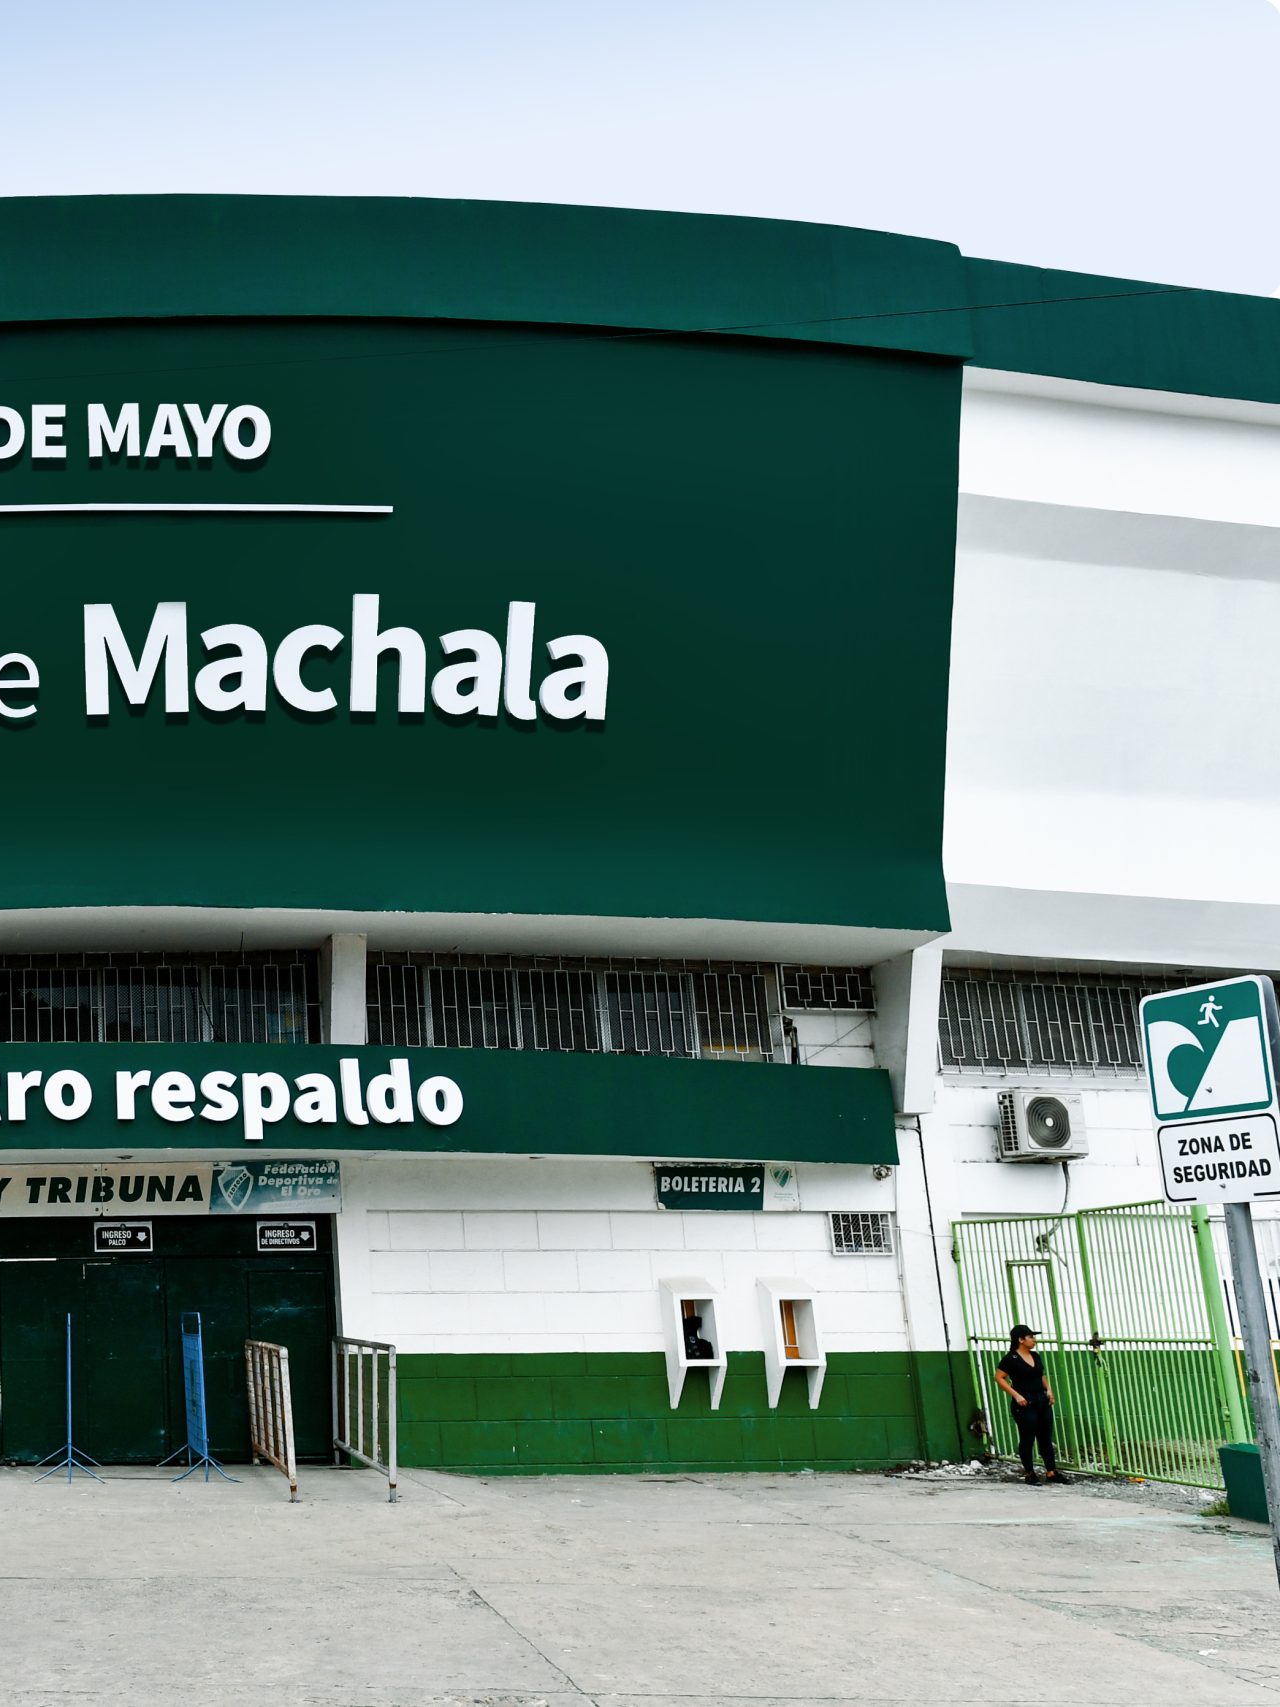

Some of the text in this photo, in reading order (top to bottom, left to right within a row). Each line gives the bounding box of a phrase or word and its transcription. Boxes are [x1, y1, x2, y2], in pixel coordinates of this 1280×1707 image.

[87, 402, 272, 460] MAYO
[83, 593, 609, 720] Machala
[116, 1058, 464, 1140] respaldo
[1178, 1132, 1253, 1156] ZONA DE
[264, 1162, 336, 1174] Federación
[1173, 1158, 1272, 1184] SEGURIDAD
[26, 1175, 204, 1204] TRIBUNA
[258, 1175, 338, 1188] Deportiva de
[281, 1186, 321, 1196] El Oro
[660, 1176, 761, 1193] BOLETERIA 2
[102, 1230, 132, 1239] INGRESO
[265, 1229, 295, 1238] INGRESO
